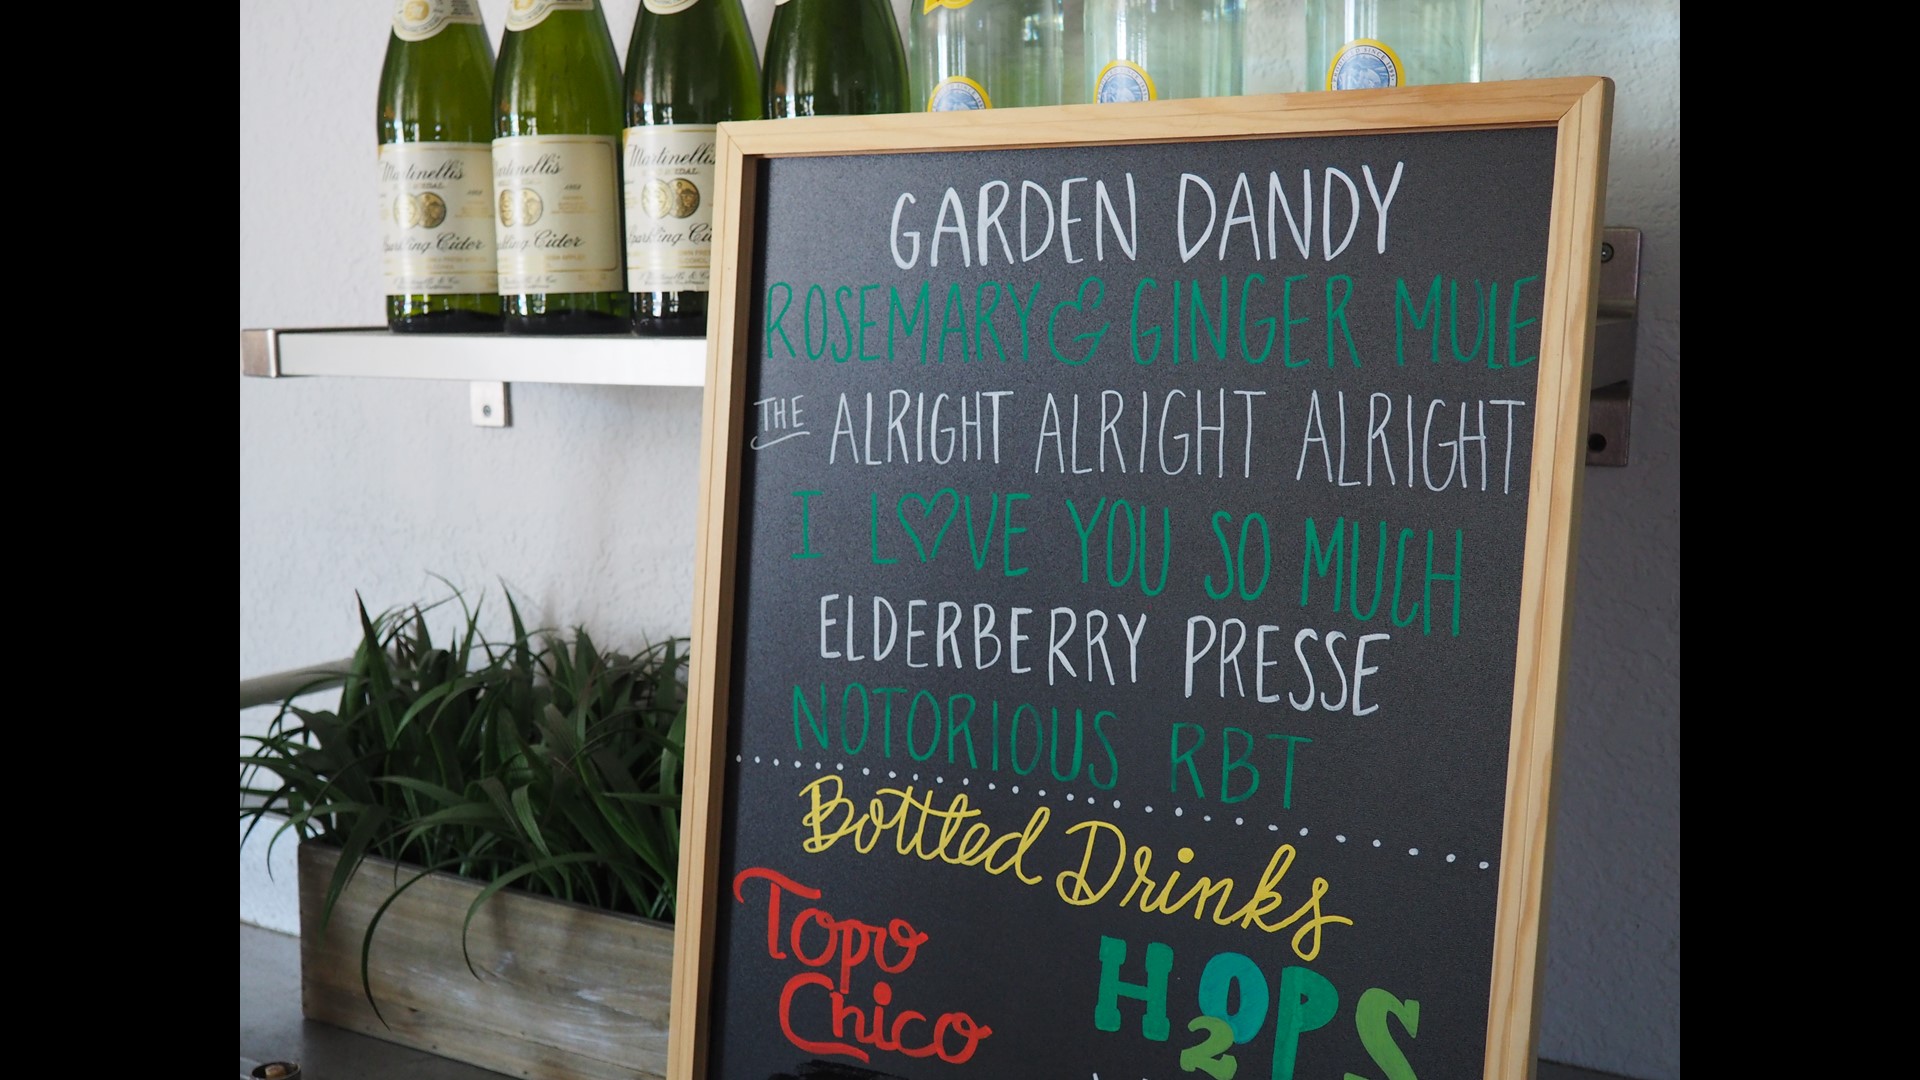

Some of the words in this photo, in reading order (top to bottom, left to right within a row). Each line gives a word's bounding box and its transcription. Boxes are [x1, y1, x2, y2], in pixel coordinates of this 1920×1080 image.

[1364, 48, 1386, 60] SINCE
[379, 159, 465, 182] Matinelli's
[494, 152, 563, 177] artinelli's
[383, 232, 432, 254] Sparling
[436, 231, 485, 254] Cider
[534, 228, 585, 251] Cider
[890, 173, 1137, 270] GARDEN
[1178, 162, 1404, 263] DANDY
[765, 280, 1042, 366] ROSEMARY
[1047, 275, 1111, 367] &
[1130, 272, 1362, 369] GINGER
[1394, 274, 1540, 369] MULE
[753, 394, 805, 432] THE
[829, 389, 1014, 466] ALRIGHT
[1034, 388, 1267, 479] ALRIGHT
[1296, 389, 1526, 495] ALRIGHT
[787, 488, 825, 560] I
[1065, 495, 1172, 598] YOU
[1203, 509, 1272, 602] SO
[1300, 515, 1464, 638] MUCH
[820, 593, 1148, 687] ELDERBERRY
[1184, 614, 1392, 717] PRESSE
[791, 681, 1121, 791] NOTORIOUS
[1169, 721, 1313, 810] RBT
[799, 774, 1052, 885] Bottled
[1055, 819, 1354, 962] Drinks
[733, 866, 930, 995] Topo
[778, 970, 993, 1065] Chico
